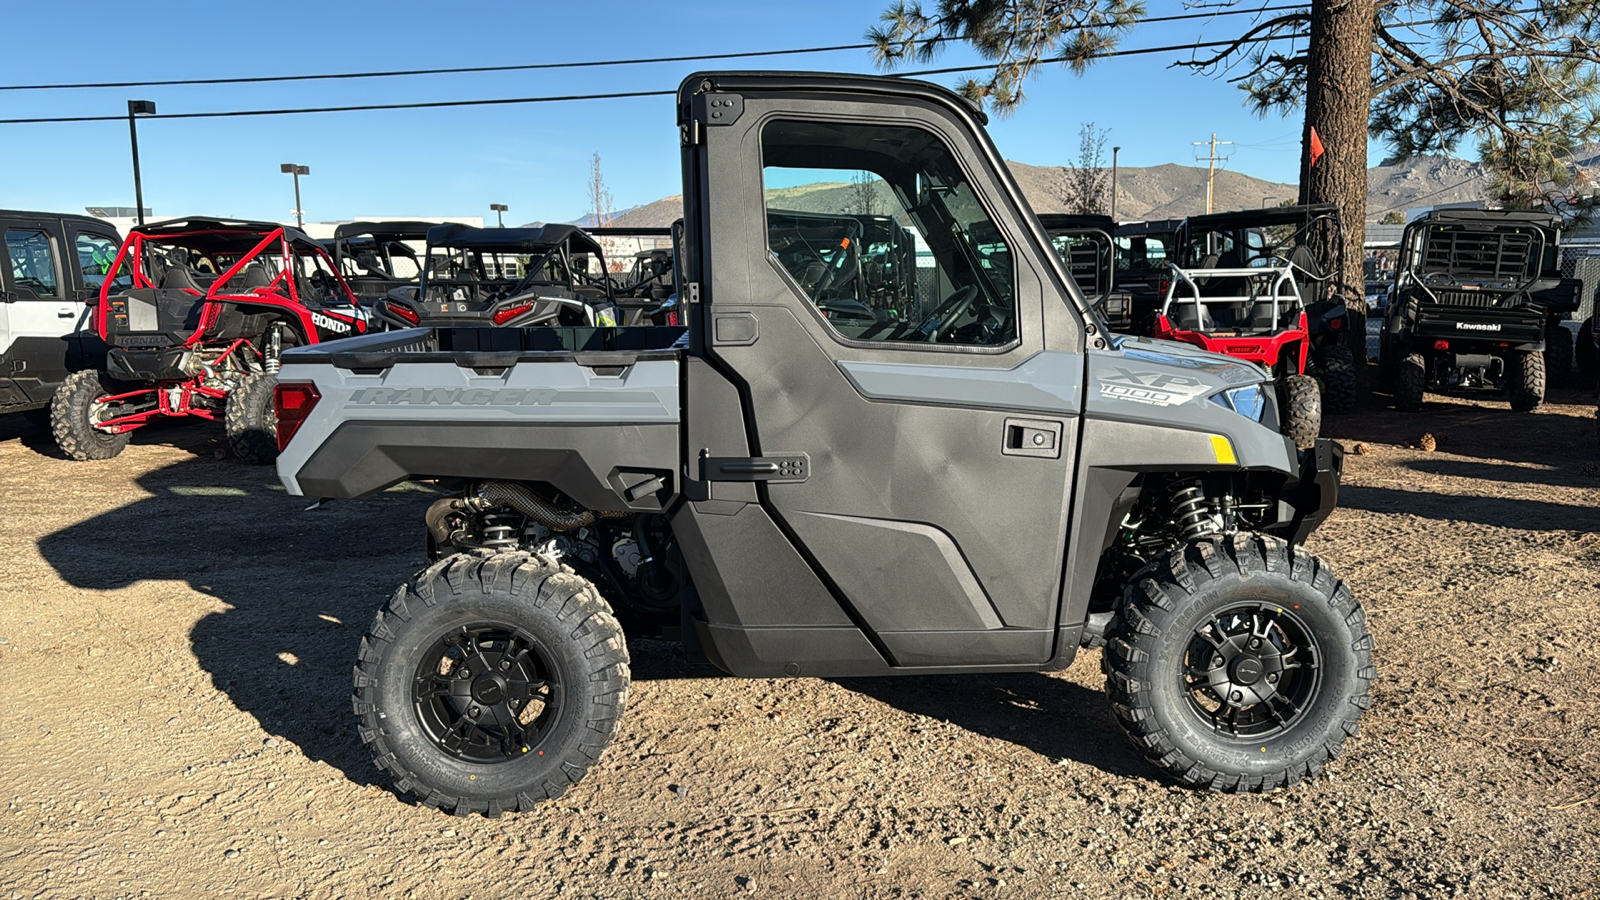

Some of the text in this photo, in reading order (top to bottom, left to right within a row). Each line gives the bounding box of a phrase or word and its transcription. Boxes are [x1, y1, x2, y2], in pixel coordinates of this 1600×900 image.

[1456, 322, 1501, 332] Kawasaki
[120, 336, 169, 345] HONDA
[1100, 366, 1202, 388] XP
[357, 387, 559, 406] RANGER
[1101, 385, 1172, 401] 1000
[1160, 590, 1220, 663] X-TERRAIN
